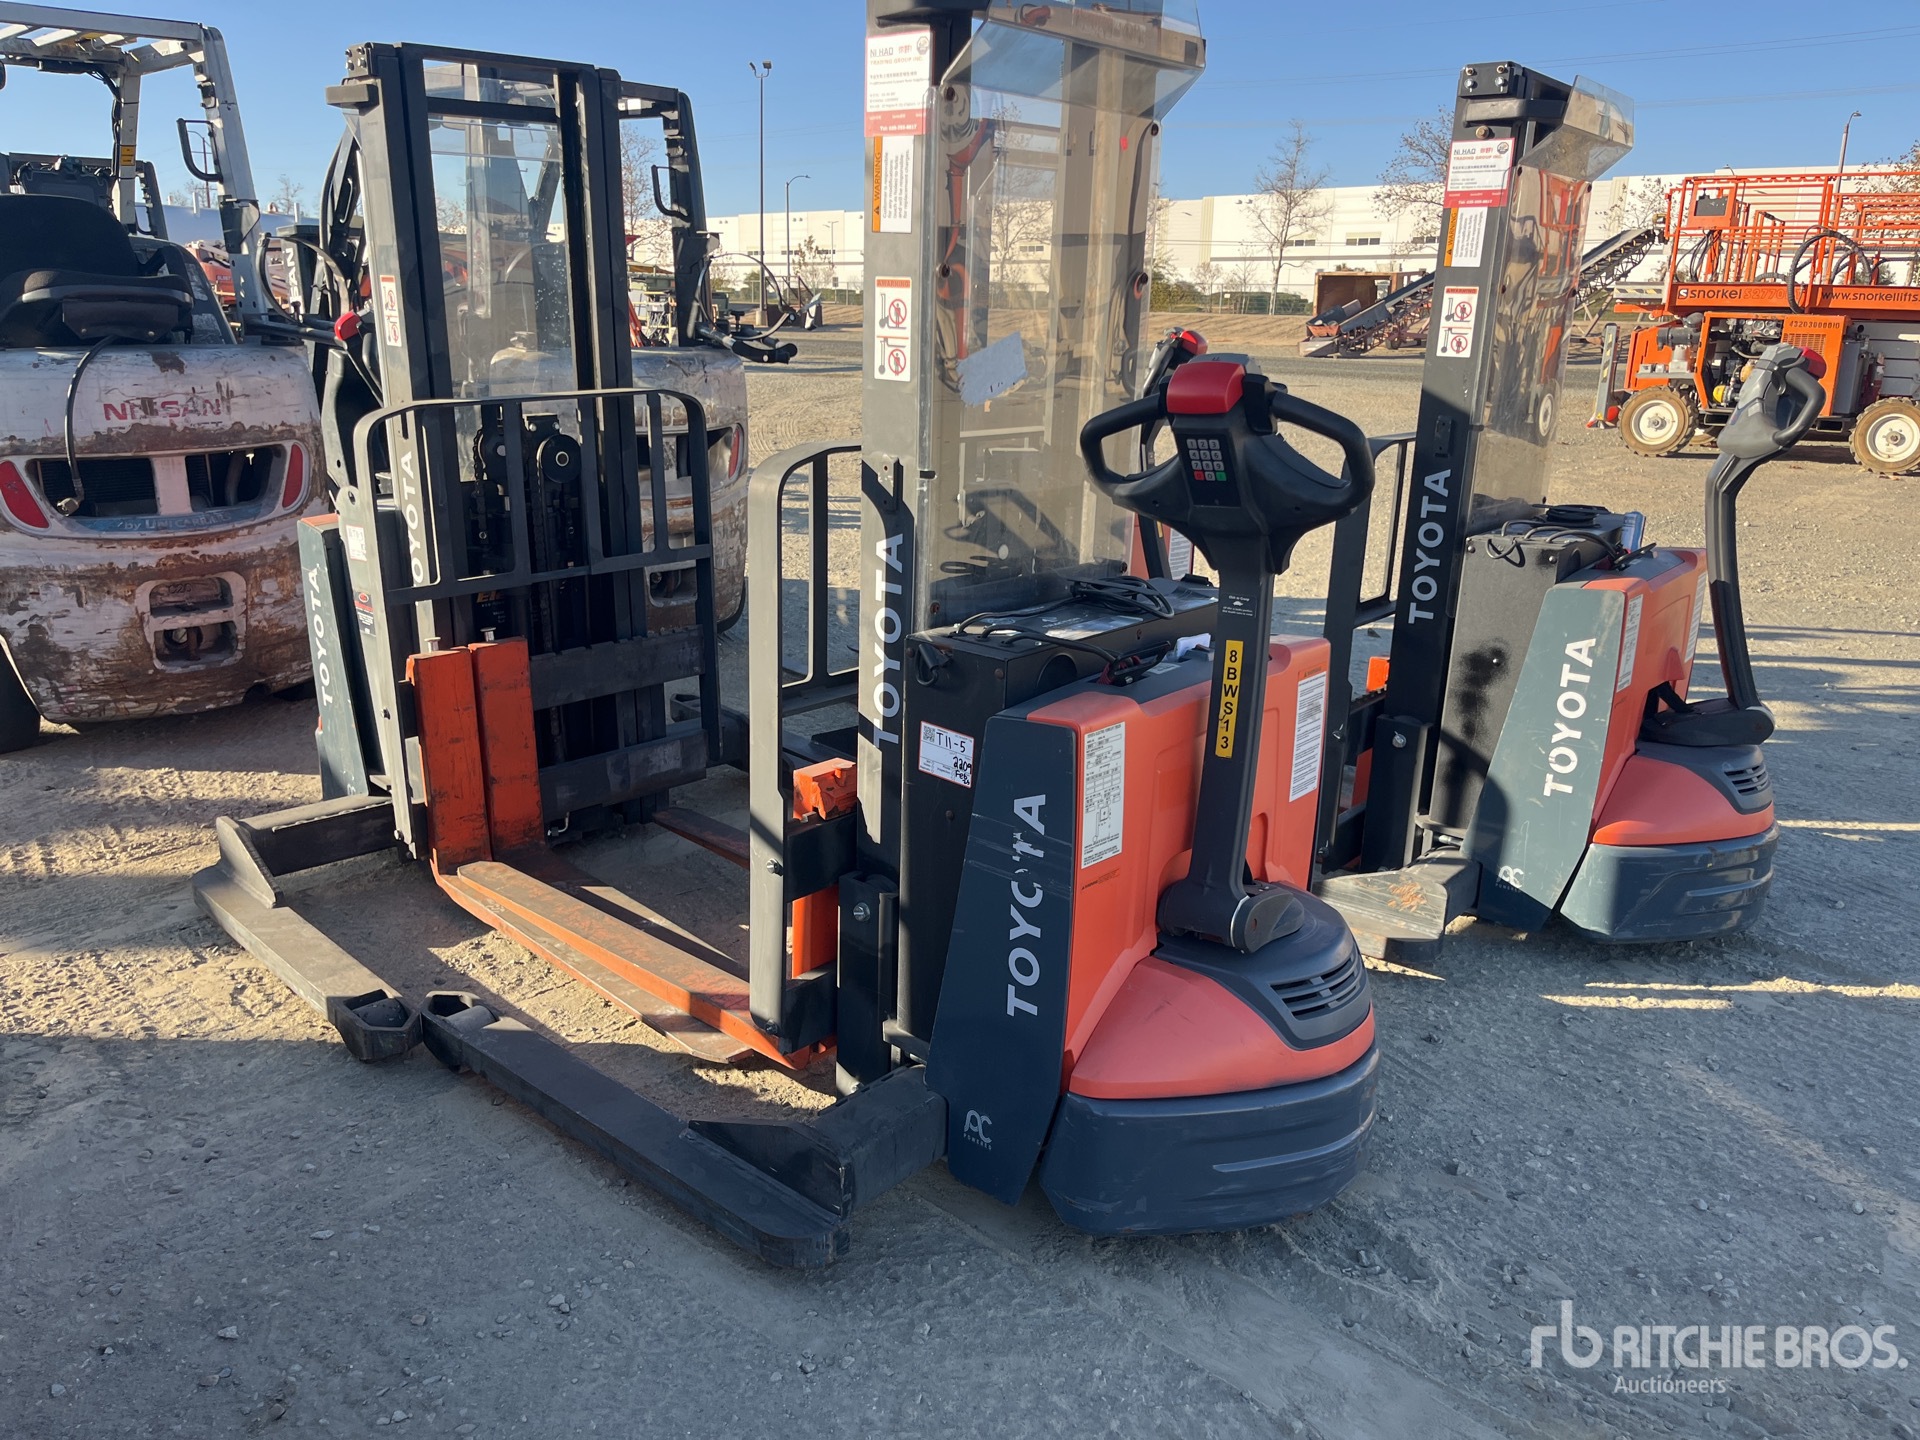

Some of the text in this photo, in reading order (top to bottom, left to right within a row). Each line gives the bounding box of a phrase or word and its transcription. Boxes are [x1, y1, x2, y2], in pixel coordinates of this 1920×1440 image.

[1448, 213, 1457, 246] WARNING
[1690, 287, 1741, 299] snorkel
[103, 398, 221, 420] NISAN
[400, 451, 424, 587] OYOTA
[1408, 468, 1451, 625] TOYOTA
[308, 564, 333, 706] TOYOTA
[872, 532, 905, 750] TOYOTA
[1220, 649, 1239, 749] 8BWS13
[1543, 637, 1596, 797] TOYOTA
